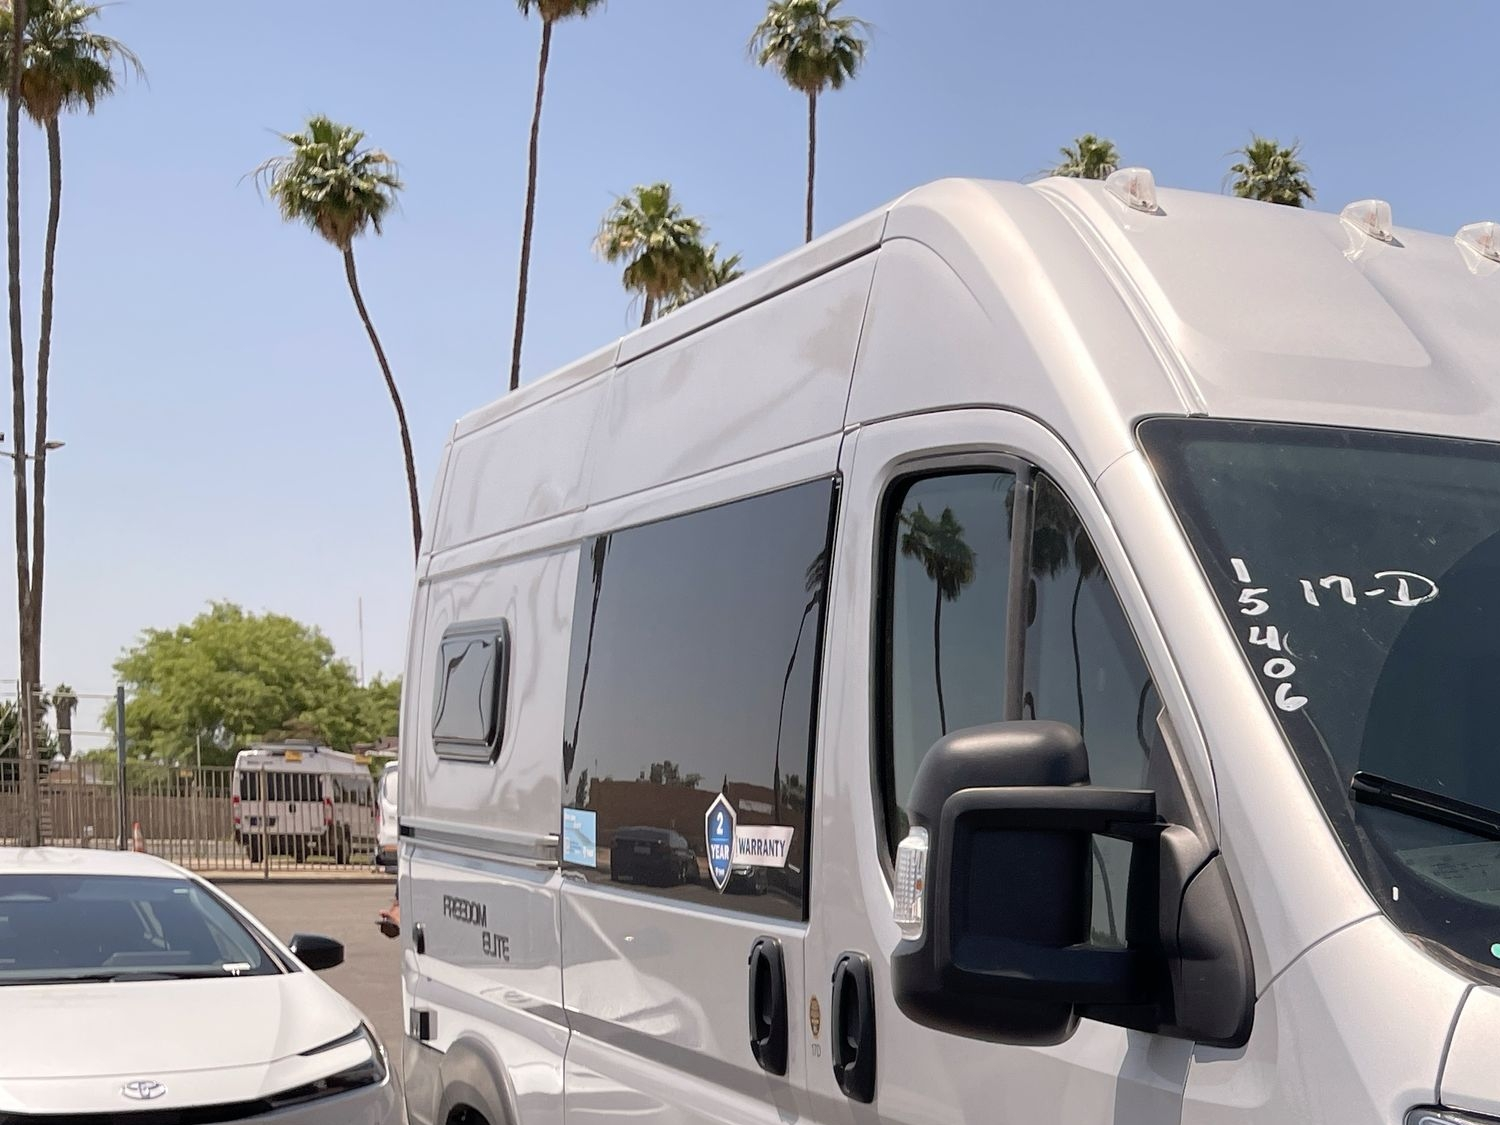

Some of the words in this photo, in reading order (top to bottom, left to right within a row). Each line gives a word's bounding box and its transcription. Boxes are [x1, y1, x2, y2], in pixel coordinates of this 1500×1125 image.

[1299, 570, 1440, 607] 17-D
[716, 811, 724, 835] 2
[710, 844, 730, 860] YEAR
[738, 838, 786, 858] WARRANTY
[443, 894, 488, 928] FREEDOM
[482, 931, 510, 962] ELITE
